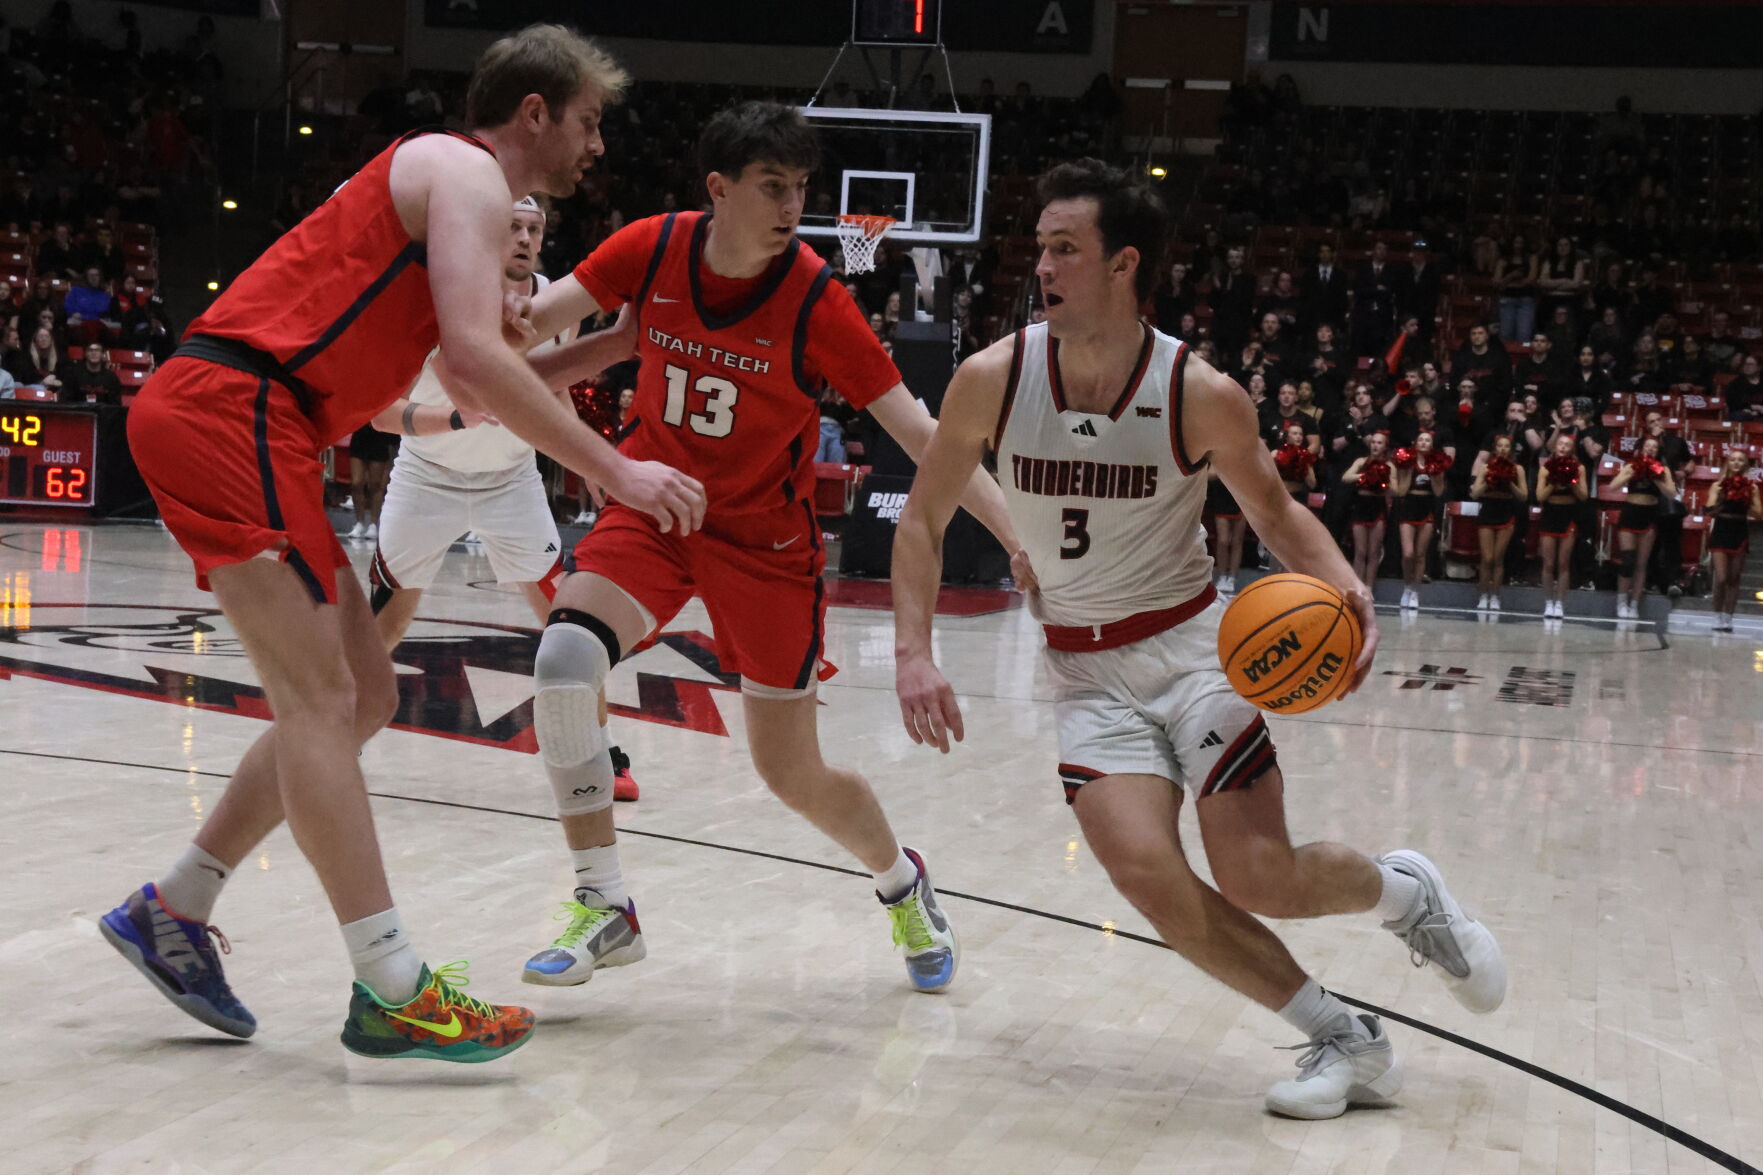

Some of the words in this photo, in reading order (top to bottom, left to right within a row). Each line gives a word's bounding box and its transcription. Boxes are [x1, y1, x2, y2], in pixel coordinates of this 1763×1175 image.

[1036, 0, 1069, 34] A
[1297, 7, 1329, 42] N
[648, 327, 703, 358] UTAH
[708, 347, 770, 373] TECH
[663, 363, 739, 439] 13
[1135, 406, 1162, 418] WAC
[1, 415, 41, 446] 42
[43, 450, 82, 464] GUEST
[1012, 453, 1159, 499] THUNDERBIRDS
[46, 466, 87, 498] 62
[1060, 507, 1091, 560] 3
[1242, 630, 1303, 684] NCAA
[1262, 651, 1345, 710] Wilson
